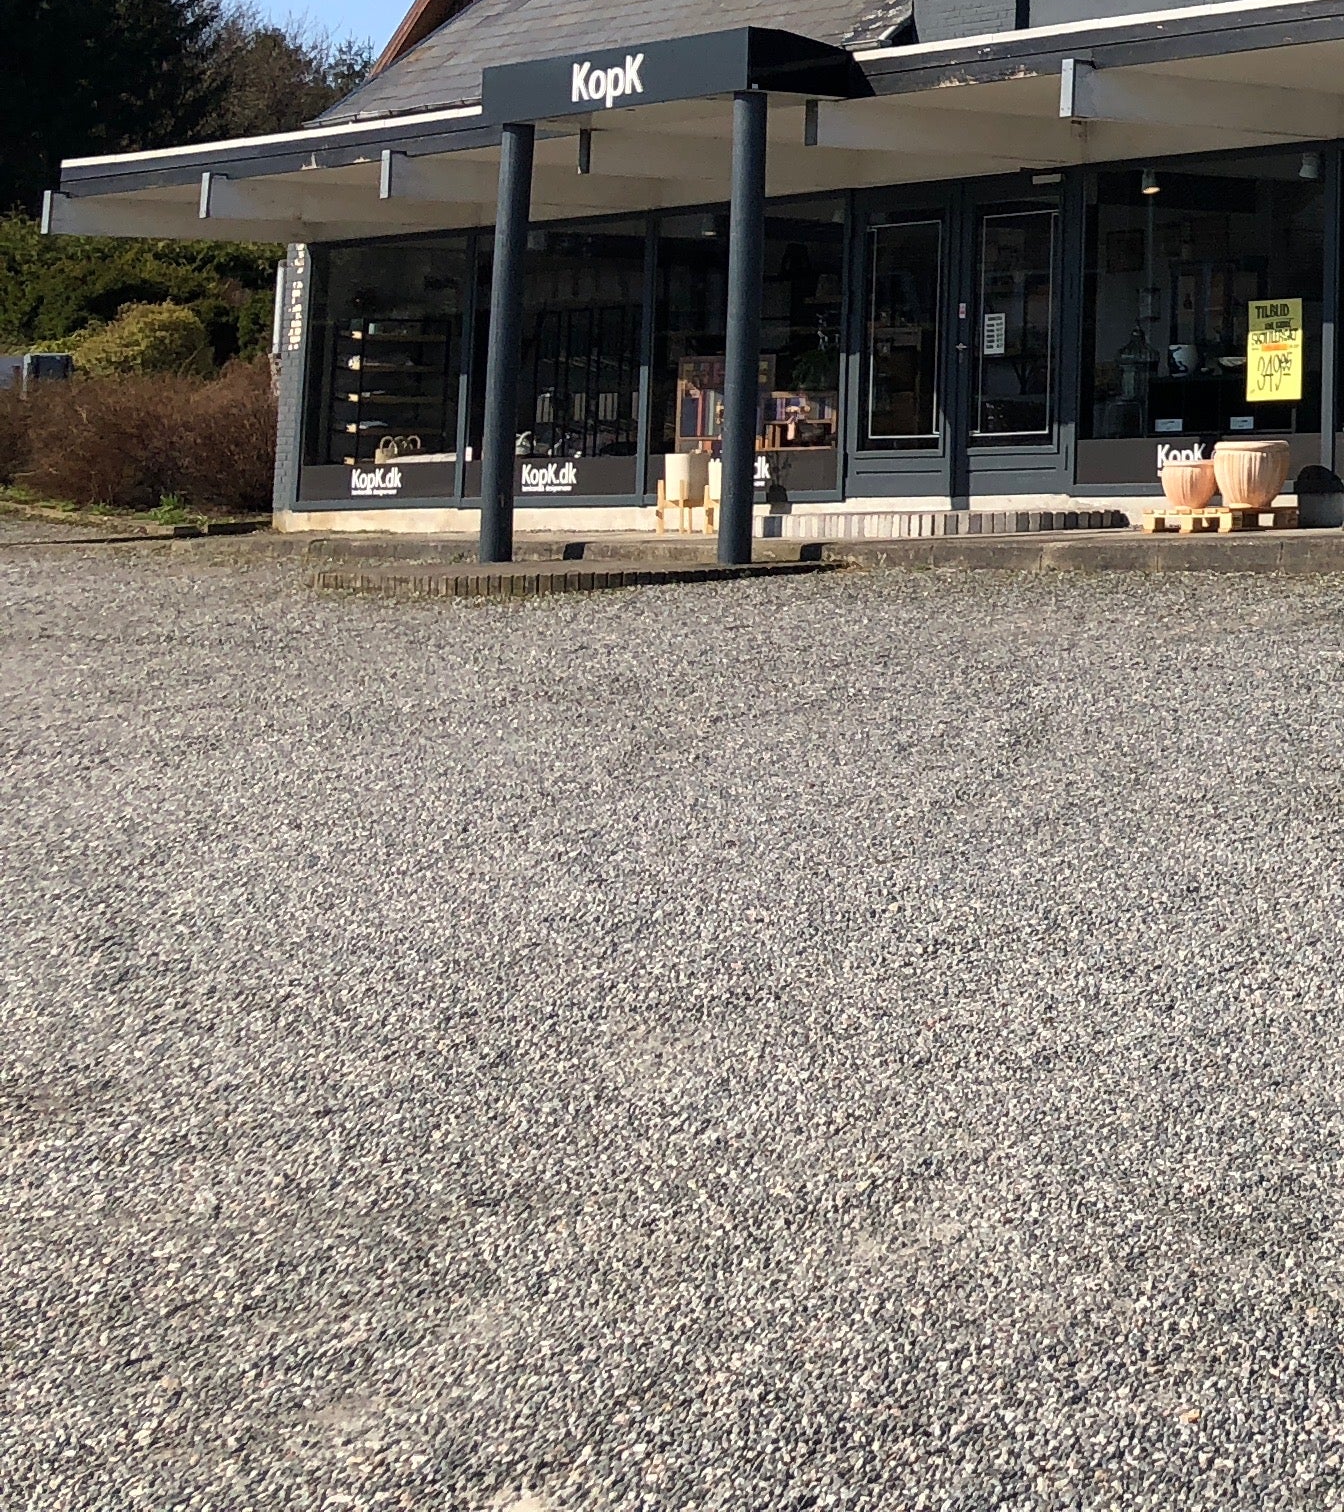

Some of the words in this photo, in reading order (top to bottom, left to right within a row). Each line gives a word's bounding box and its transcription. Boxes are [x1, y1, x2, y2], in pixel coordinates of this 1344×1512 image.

[571, 53, 645, 108] KopK
[351, 467, 402, 494] KopK.dk
[522, 462, 577, 491] KopK.dk
